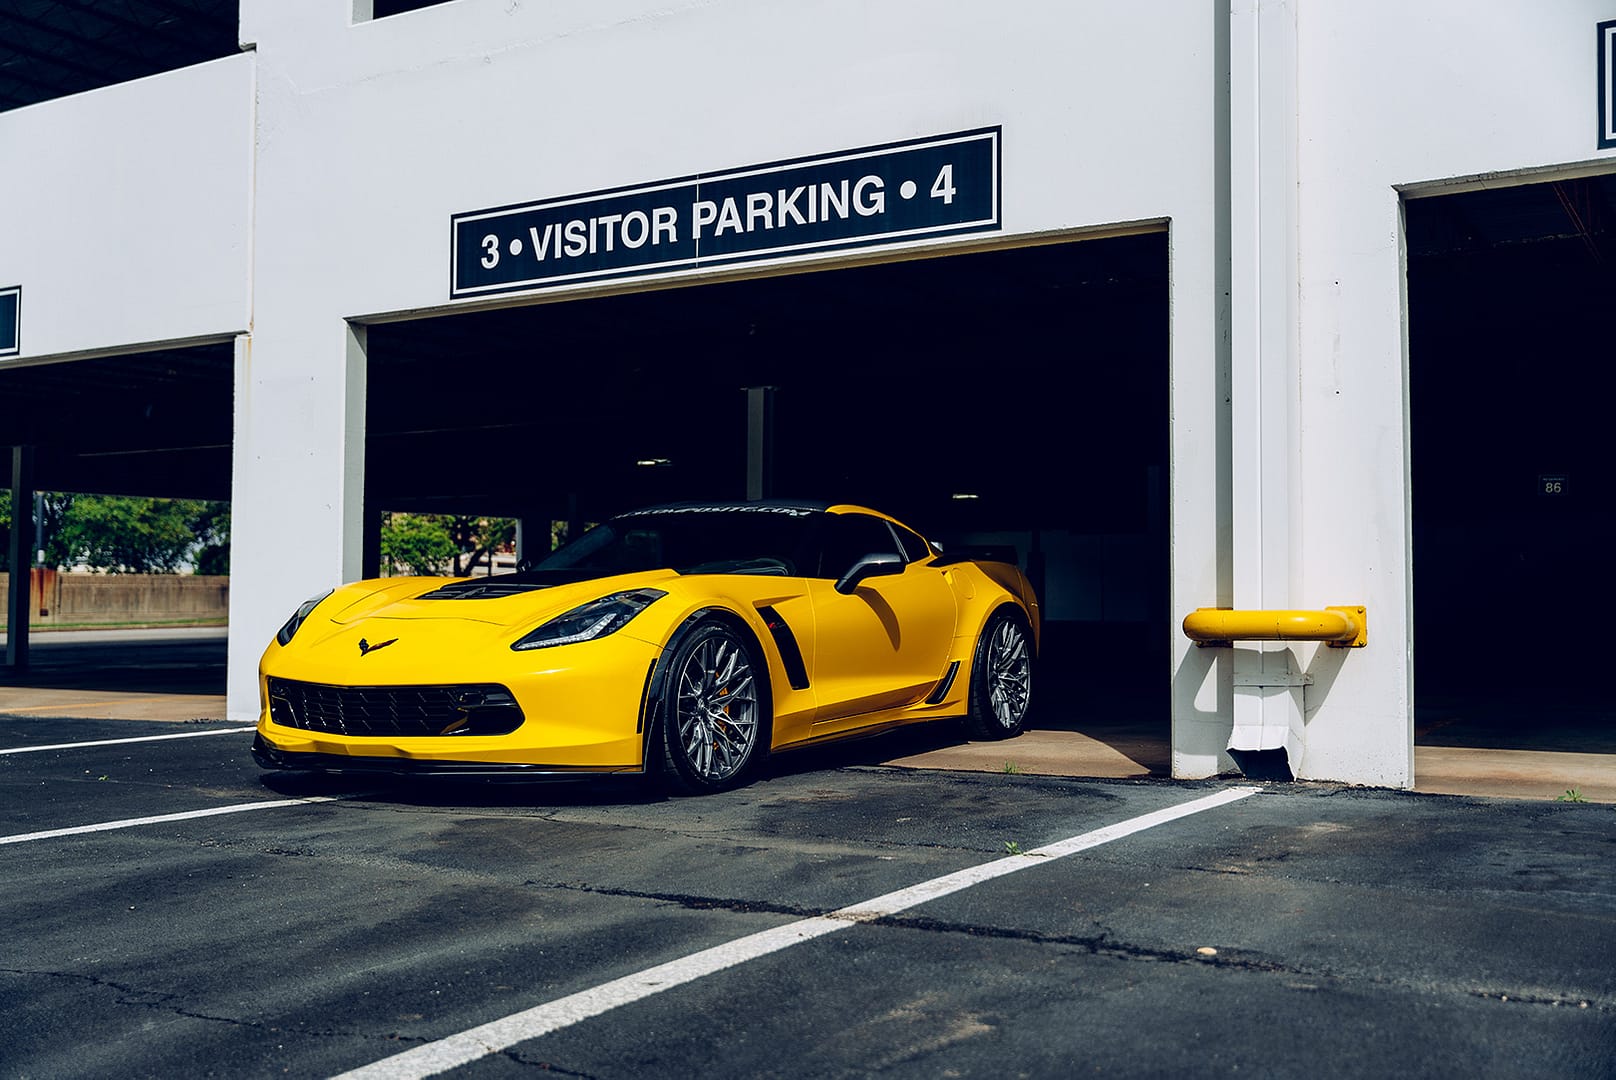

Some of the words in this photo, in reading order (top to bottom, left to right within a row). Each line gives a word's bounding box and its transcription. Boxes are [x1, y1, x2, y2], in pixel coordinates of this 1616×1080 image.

[480, 234, 500, 269] 3
[529, 206, 678, 262] VISITOR
[692, 175, 885, 239] PARKING
[930, 164, 957, 205] 4
[1545, 482, 1562, 494] 86
